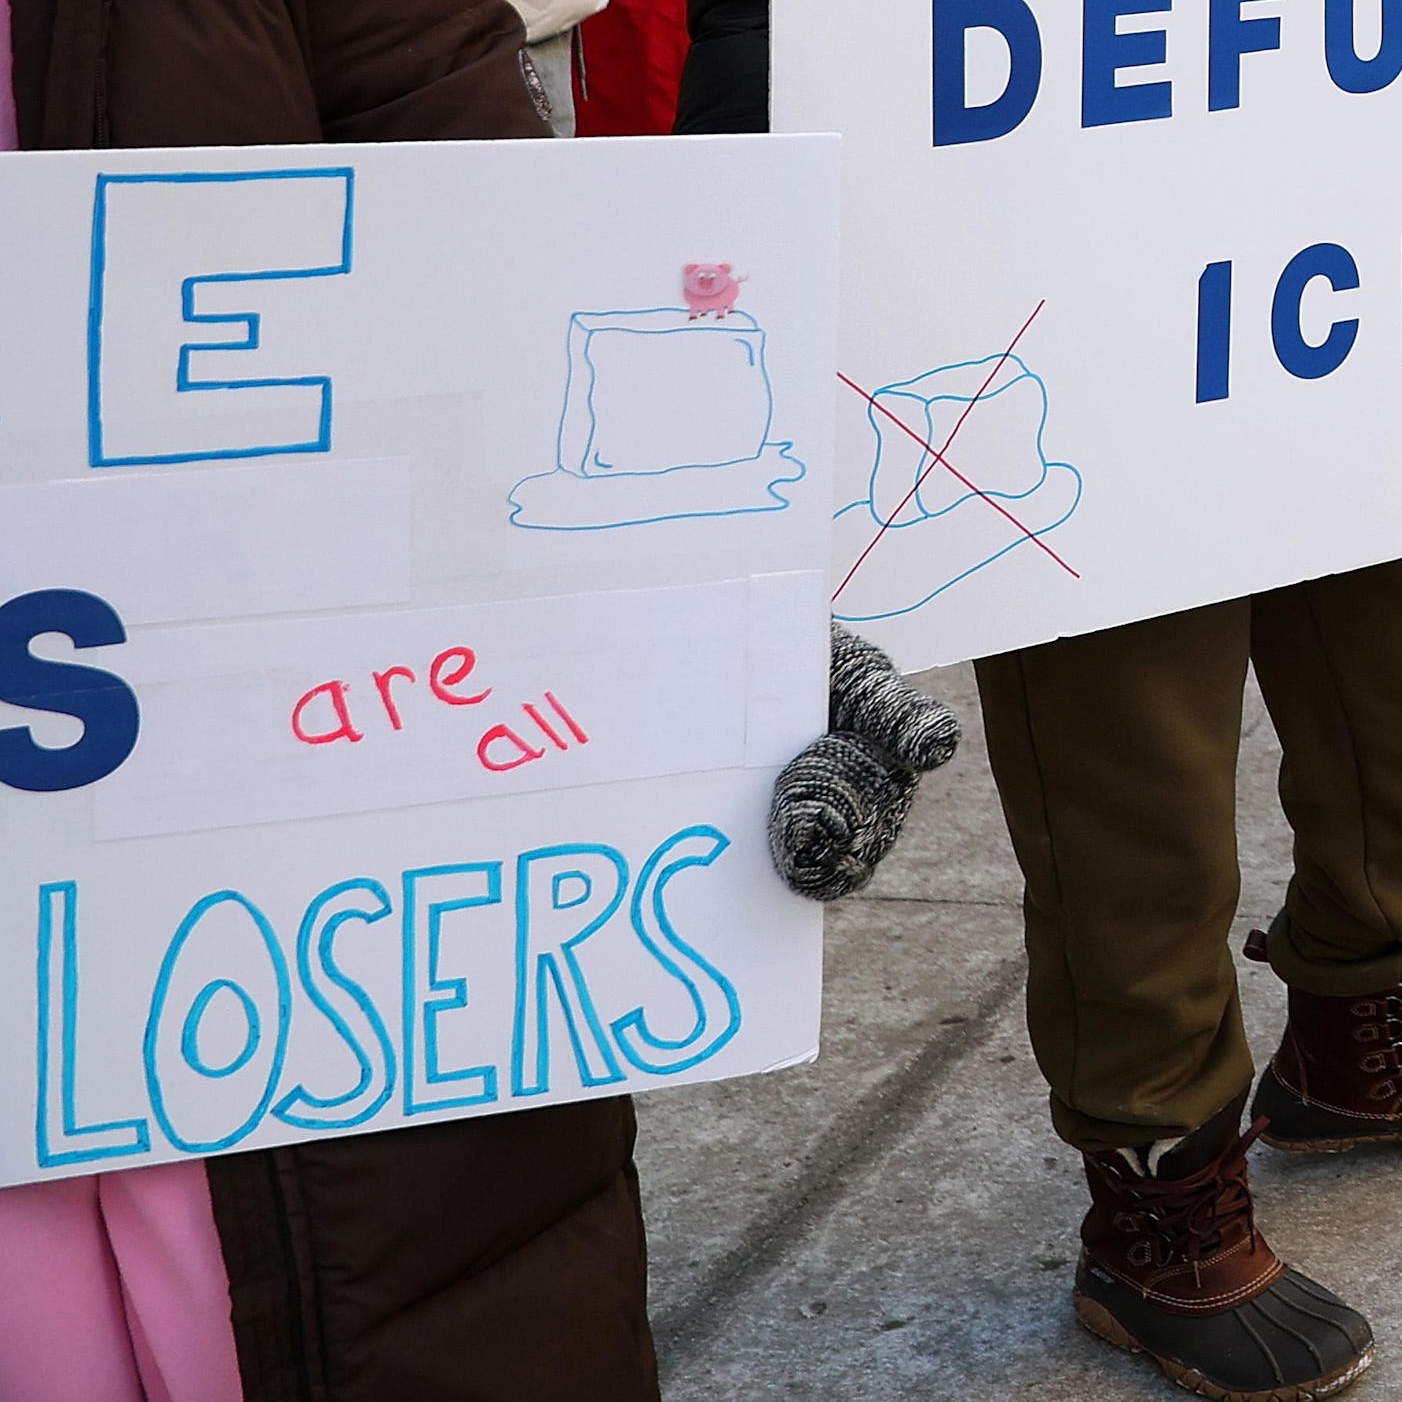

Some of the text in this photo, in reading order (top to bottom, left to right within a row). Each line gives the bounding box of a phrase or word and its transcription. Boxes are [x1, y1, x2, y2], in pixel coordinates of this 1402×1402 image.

[291, 644, 494, 745] are
[474, 690, 590, 773] all
[36, 824, 742, 1169] LOSERS
